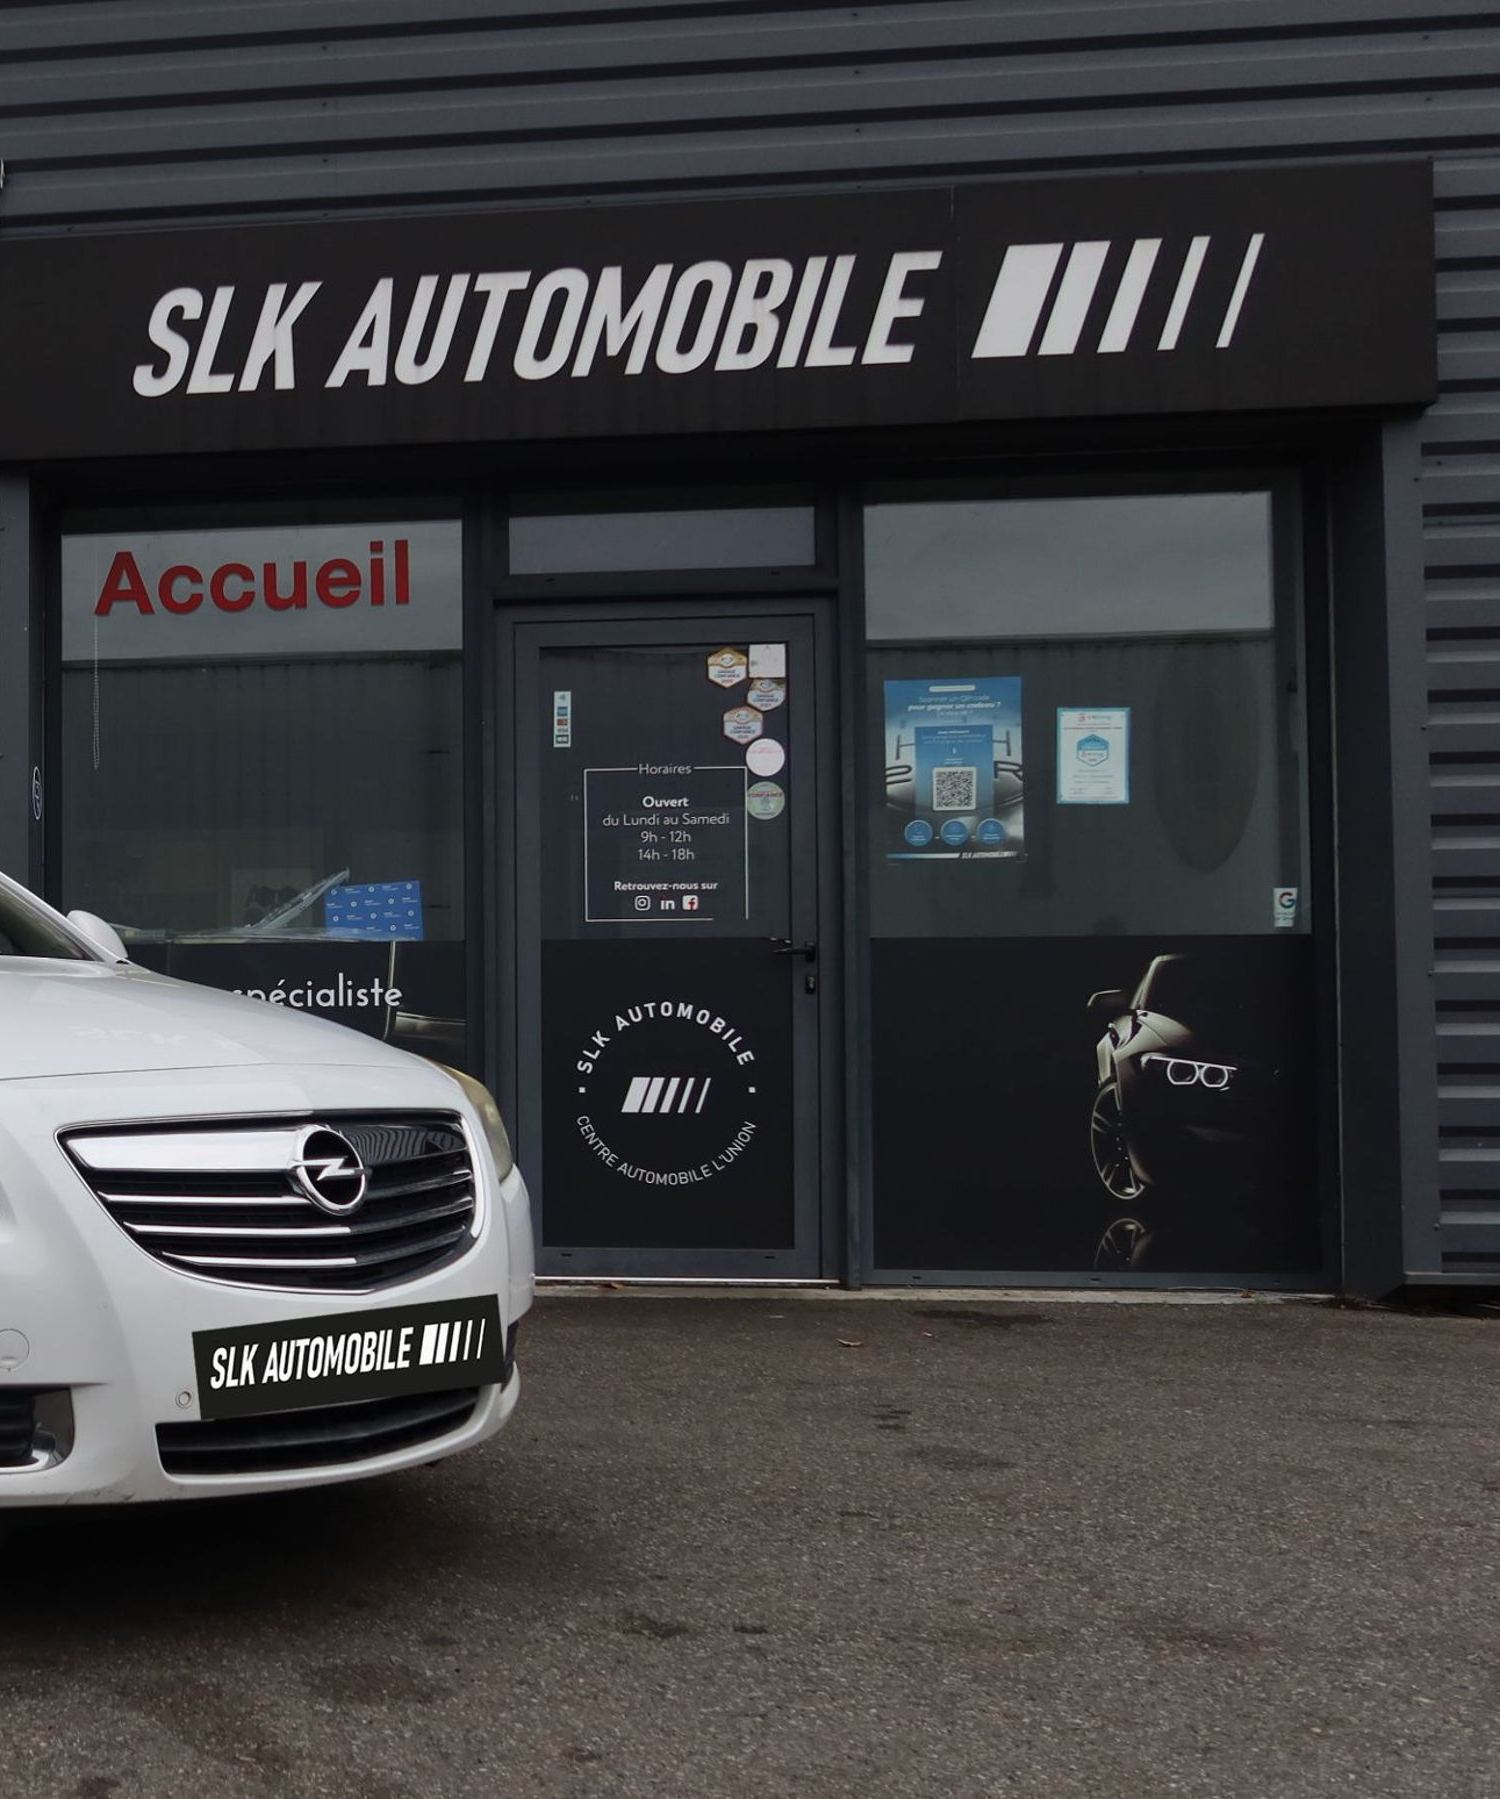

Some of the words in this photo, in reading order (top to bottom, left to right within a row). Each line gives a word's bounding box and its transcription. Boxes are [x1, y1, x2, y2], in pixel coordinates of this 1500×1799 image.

[132, 281, 323, 397] SLK
[324, 250, 943, 388] AUTOMOBILE
[94, 539, 411, 616] Accueil
[638, 763, 692, 775] Horaires
[642, 795, 689, 808] Ouvert
[602, 814, 619, 827] du
[623, 813, 660, 826] Lundi
[663, 816, 679, 826] au
[682, 812, 730, 825] Samedi
[640, 830, 658, 844] 9h
[669, 830, 692, 843] 12h
[638, 848, 661, 861] 14h
[671, 847, 695, 861] 18h
[613, 880, 699, 892] Retrouvez-nous
[700, 882, 719, 891] sur
[232, 972, 403, 1008] écialiste
[576, 1029, 611, 1074] SLK
[615, 1001, 755, 1066] AUTOMOBILE
[576, 1115, 619, 1167] CENTRE
[616, 1162, 713, 1186] AUTOMOBILE
[711, 1120, 757, 1171] L'UNION
[210, 1343, 259, 1390] SLK
[261, 1326, 414, 1384] AUTOMOBILE
